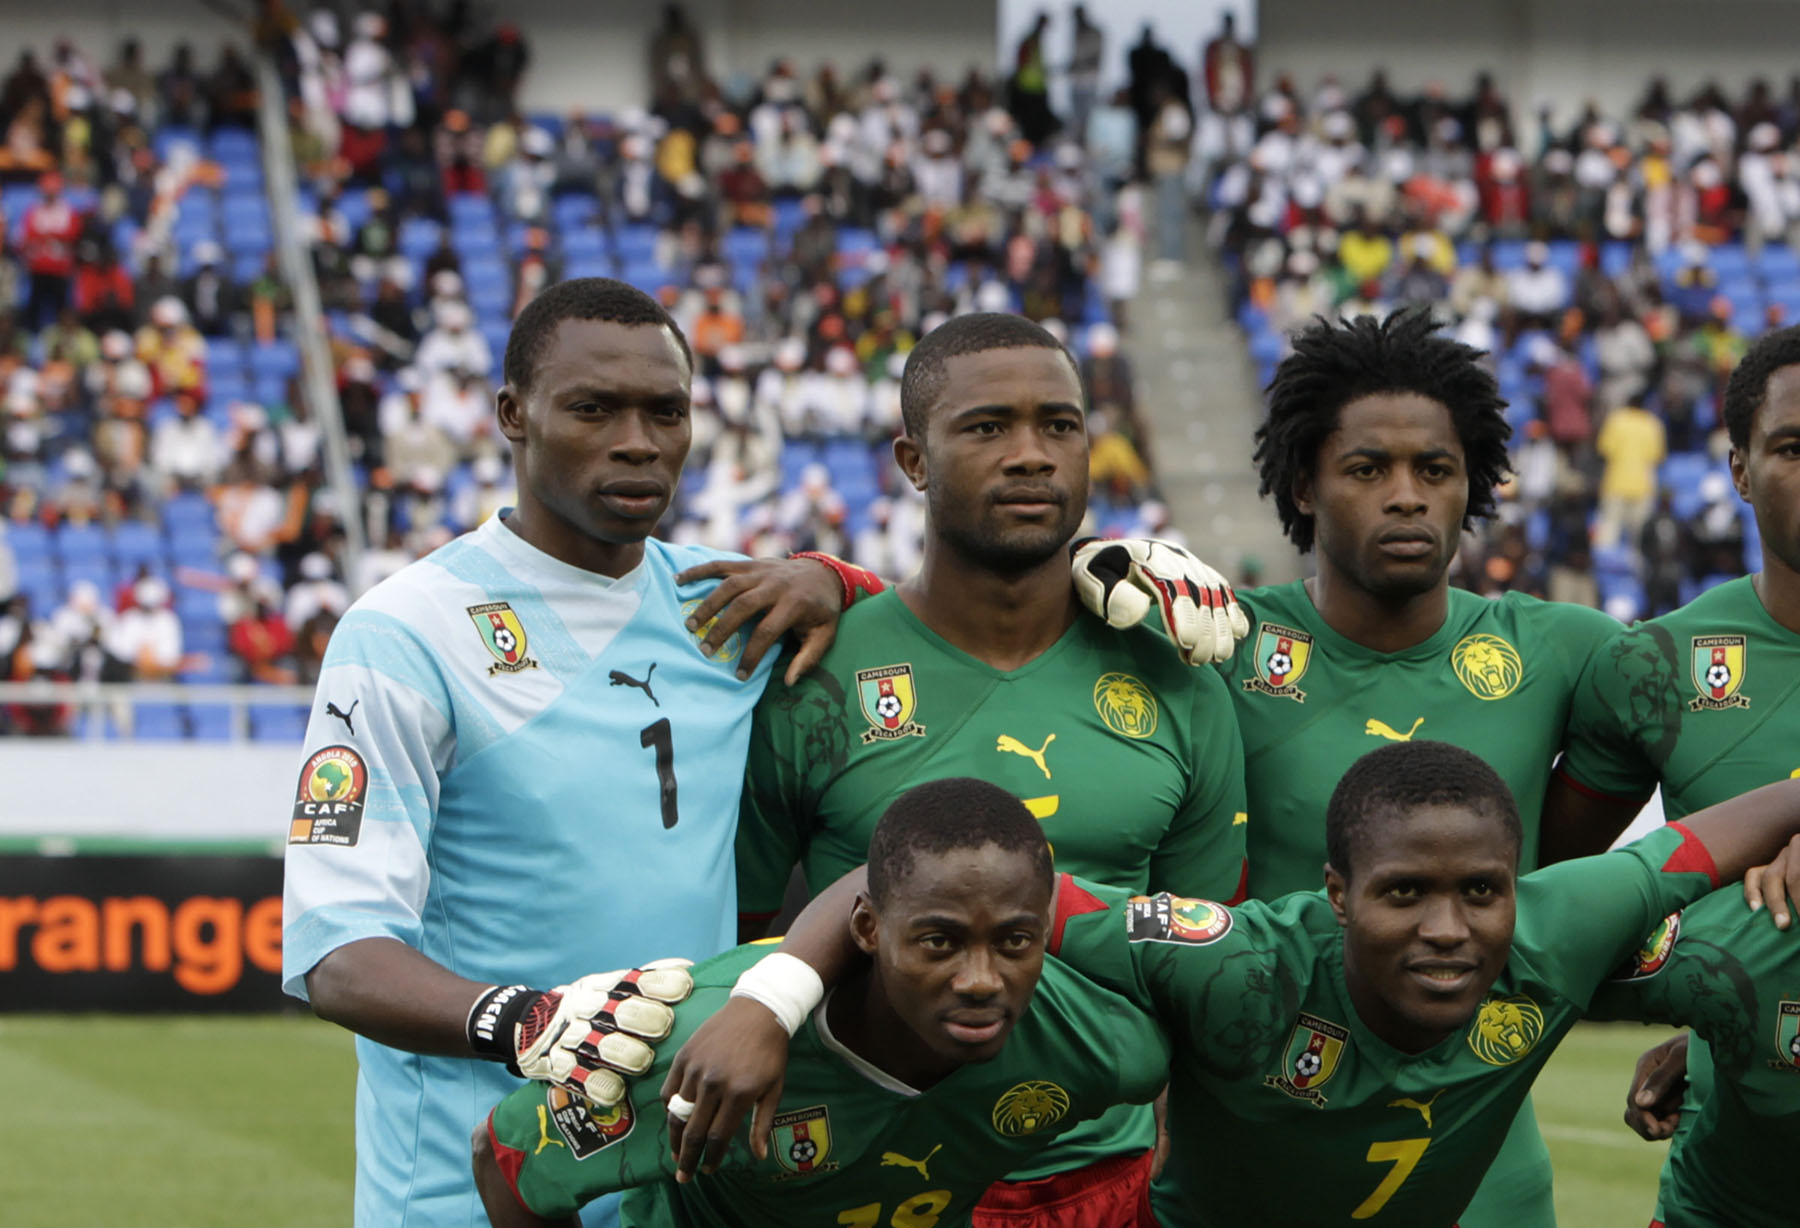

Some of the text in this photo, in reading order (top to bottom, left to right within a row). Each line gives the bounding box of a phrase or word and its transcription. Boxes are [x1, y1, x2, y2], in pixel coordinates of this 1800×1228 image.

[1265, 625, 1309, 642] CAMEROUN
[1697, 638, 1741, 647] CAMEROUN
[860, 666, 907, 680] CAMEROUN
[640, 718, 678, 829] 1
[304, 803, 348, 815] CAF
[1351, 1137, 1432, 1220] 7
